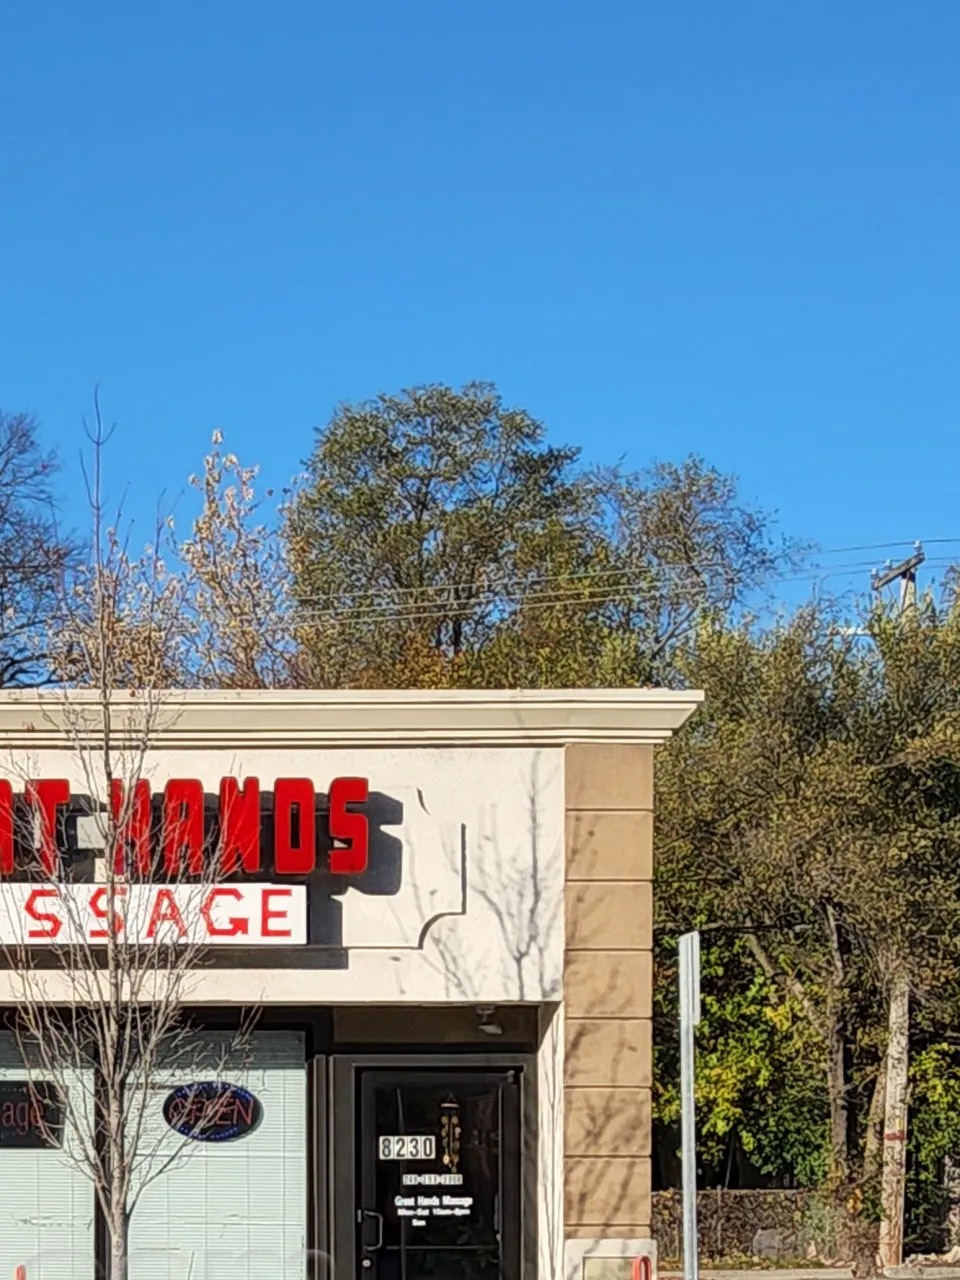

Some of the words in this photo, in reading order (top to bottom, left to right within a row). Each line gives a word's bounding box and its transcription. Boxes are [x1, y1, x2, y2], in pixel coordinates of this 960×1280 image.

[110, 776, 369, 874] HANDS
[167, 1097, 254, 1126] OPEN
[381, 1137, 433, 1158] 8230
